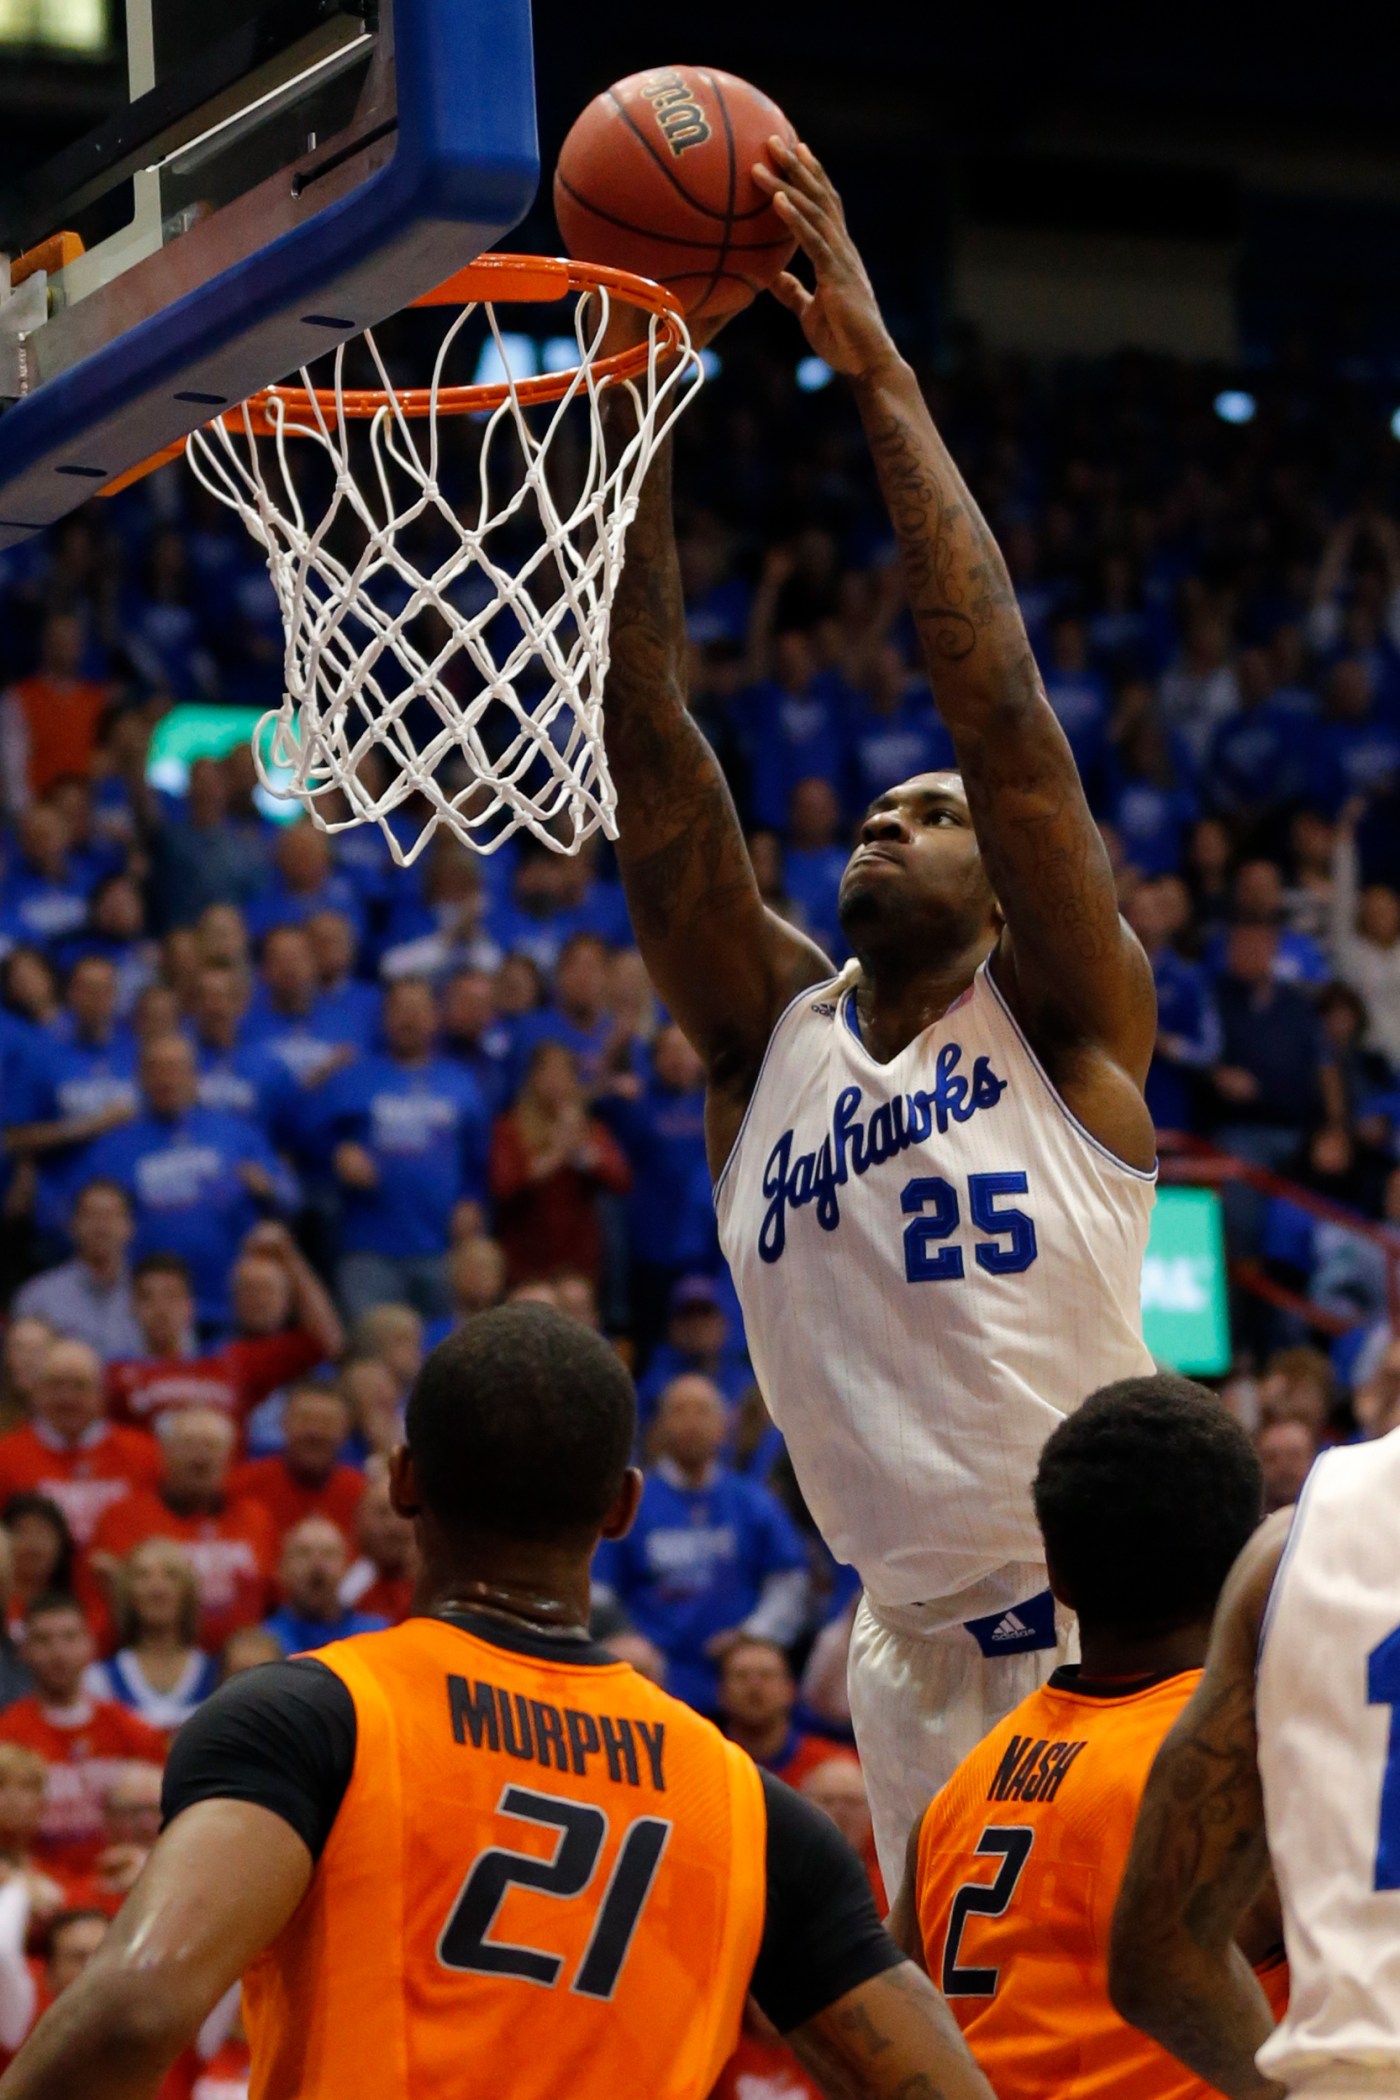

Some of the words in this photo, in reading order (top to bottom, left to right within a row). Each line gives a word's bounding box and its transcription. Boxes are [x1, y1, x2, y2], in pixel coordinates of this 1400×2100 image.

[641, 72, 712, 157] Wil
[758, 1042, 1007, 1263] Jayhawks
[900, 1171, 1037, 1283] 25
[991, 1628, 1036, 1641] adidas
[447, 1673, 666, 1791] MURPHY
[987, 1735, 1087, 1802] NASH
[435, 1782, 673, 2002] 21
[942, 1825, 1034, 1998] 2
